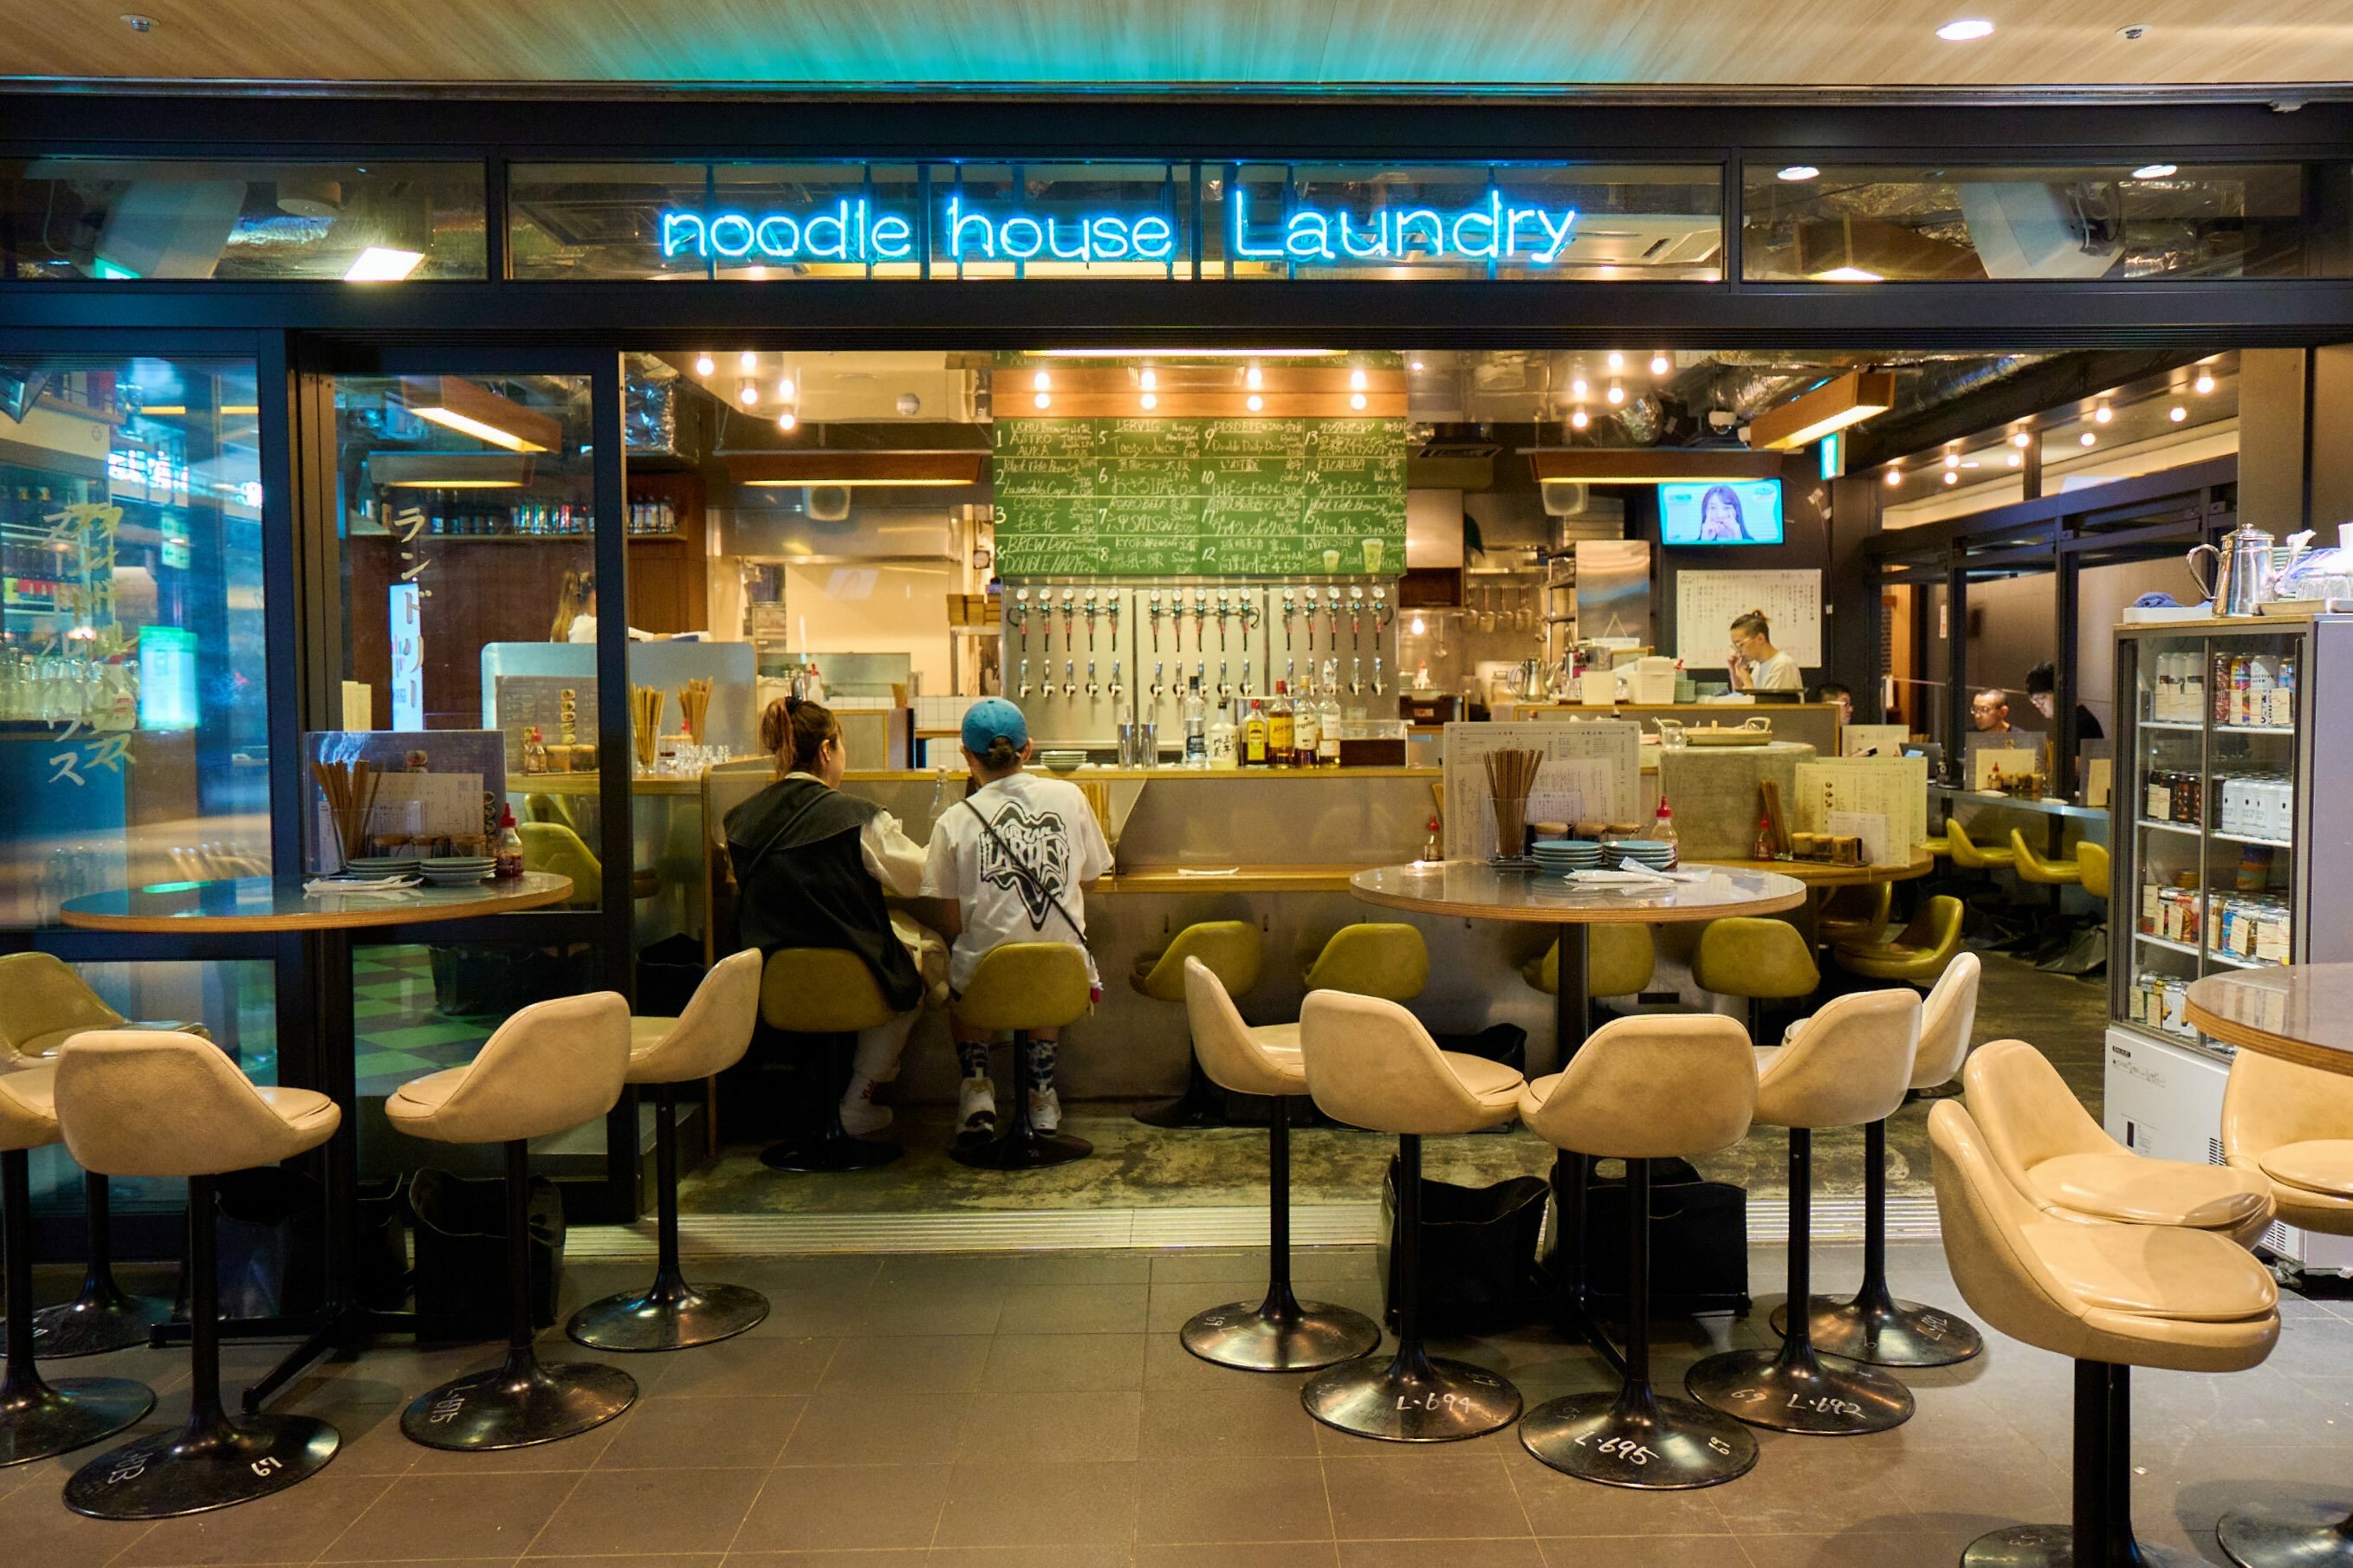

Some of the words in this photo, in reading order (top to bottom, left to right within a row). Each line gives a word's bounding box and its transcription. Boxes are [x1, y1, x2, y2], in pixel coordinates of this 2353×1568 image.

[661, 198, 912, 261] noodle
[944, 195, 1174, 261] house
[1232, 187, 1578, 267] Laundry
[1115, 420, 1161, 431] LERVIG
[996, 430, 1002, 448] 1
[1010, 433, 1053, 444] ASTRO
[1099, 431, 1108, 444] 5
[1204, 428, 1215, 450] 9
[1305, 431, 1319, 445] 13
[995, 469, 1005, 484] 2
[1099, 467, 1108, 483] 6
[1202, 470, 1215, 484] 10
[995, 507, 1007, 524] 3
[1099, 509, 1108, 525] 7
[1100, 547, 1109, 561] 8
[1202, 547, 1216, 561] 12
[1003, 554, 1052, 573] DOUBLE
[395, 508, 432, 709] ランドリー
